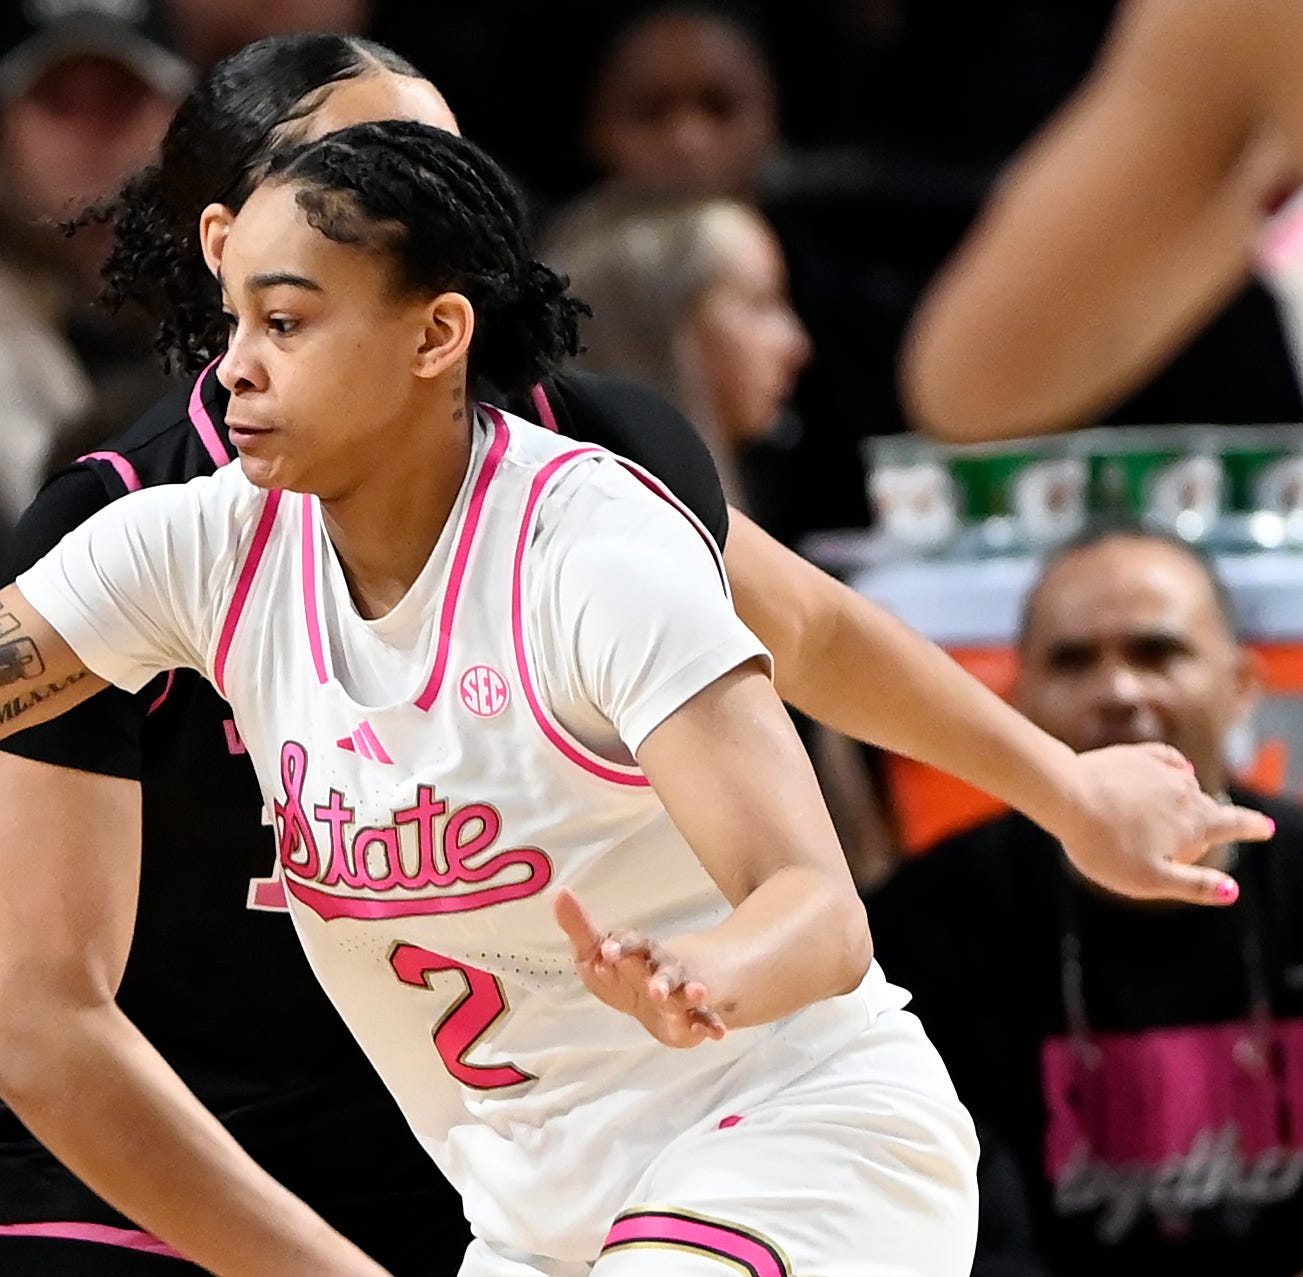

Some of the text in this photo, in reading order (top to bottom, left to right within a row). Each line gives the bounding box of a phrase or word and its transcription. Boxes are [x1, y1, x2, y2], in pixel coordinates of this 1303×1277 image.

[460, 666, 507, 716] SEC
[274, 739, 552, 922] State
[388, 939, 539, 1095] 2
